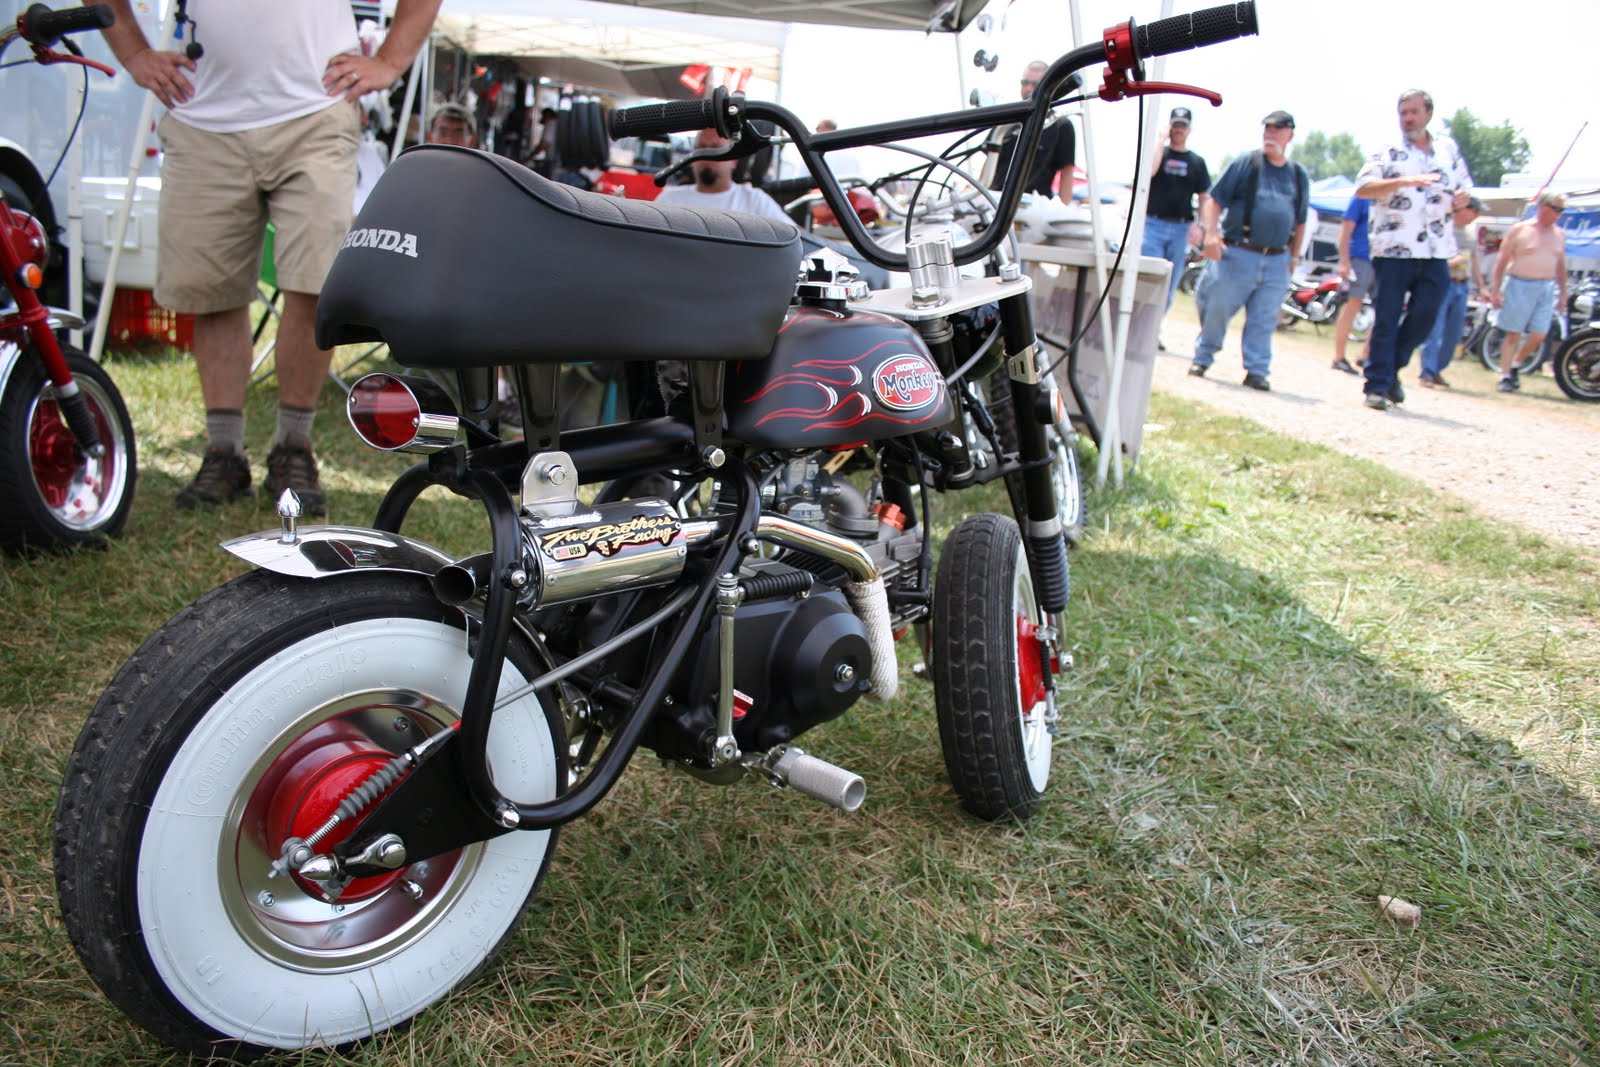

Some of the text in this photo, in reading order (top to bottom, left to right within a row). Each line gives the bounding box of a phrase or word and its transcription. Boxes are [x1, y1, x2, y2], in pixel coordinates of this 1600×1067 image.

[341, 228, 419, 258] HONDA
[894, 362, 926, 372] HONDA
[880, 370, 935, 402] Monkey
[543, 516, 676, 549] Two Brothers
[609, 527, 677, 548] Racing
[569, 546, 582, 555] USA
